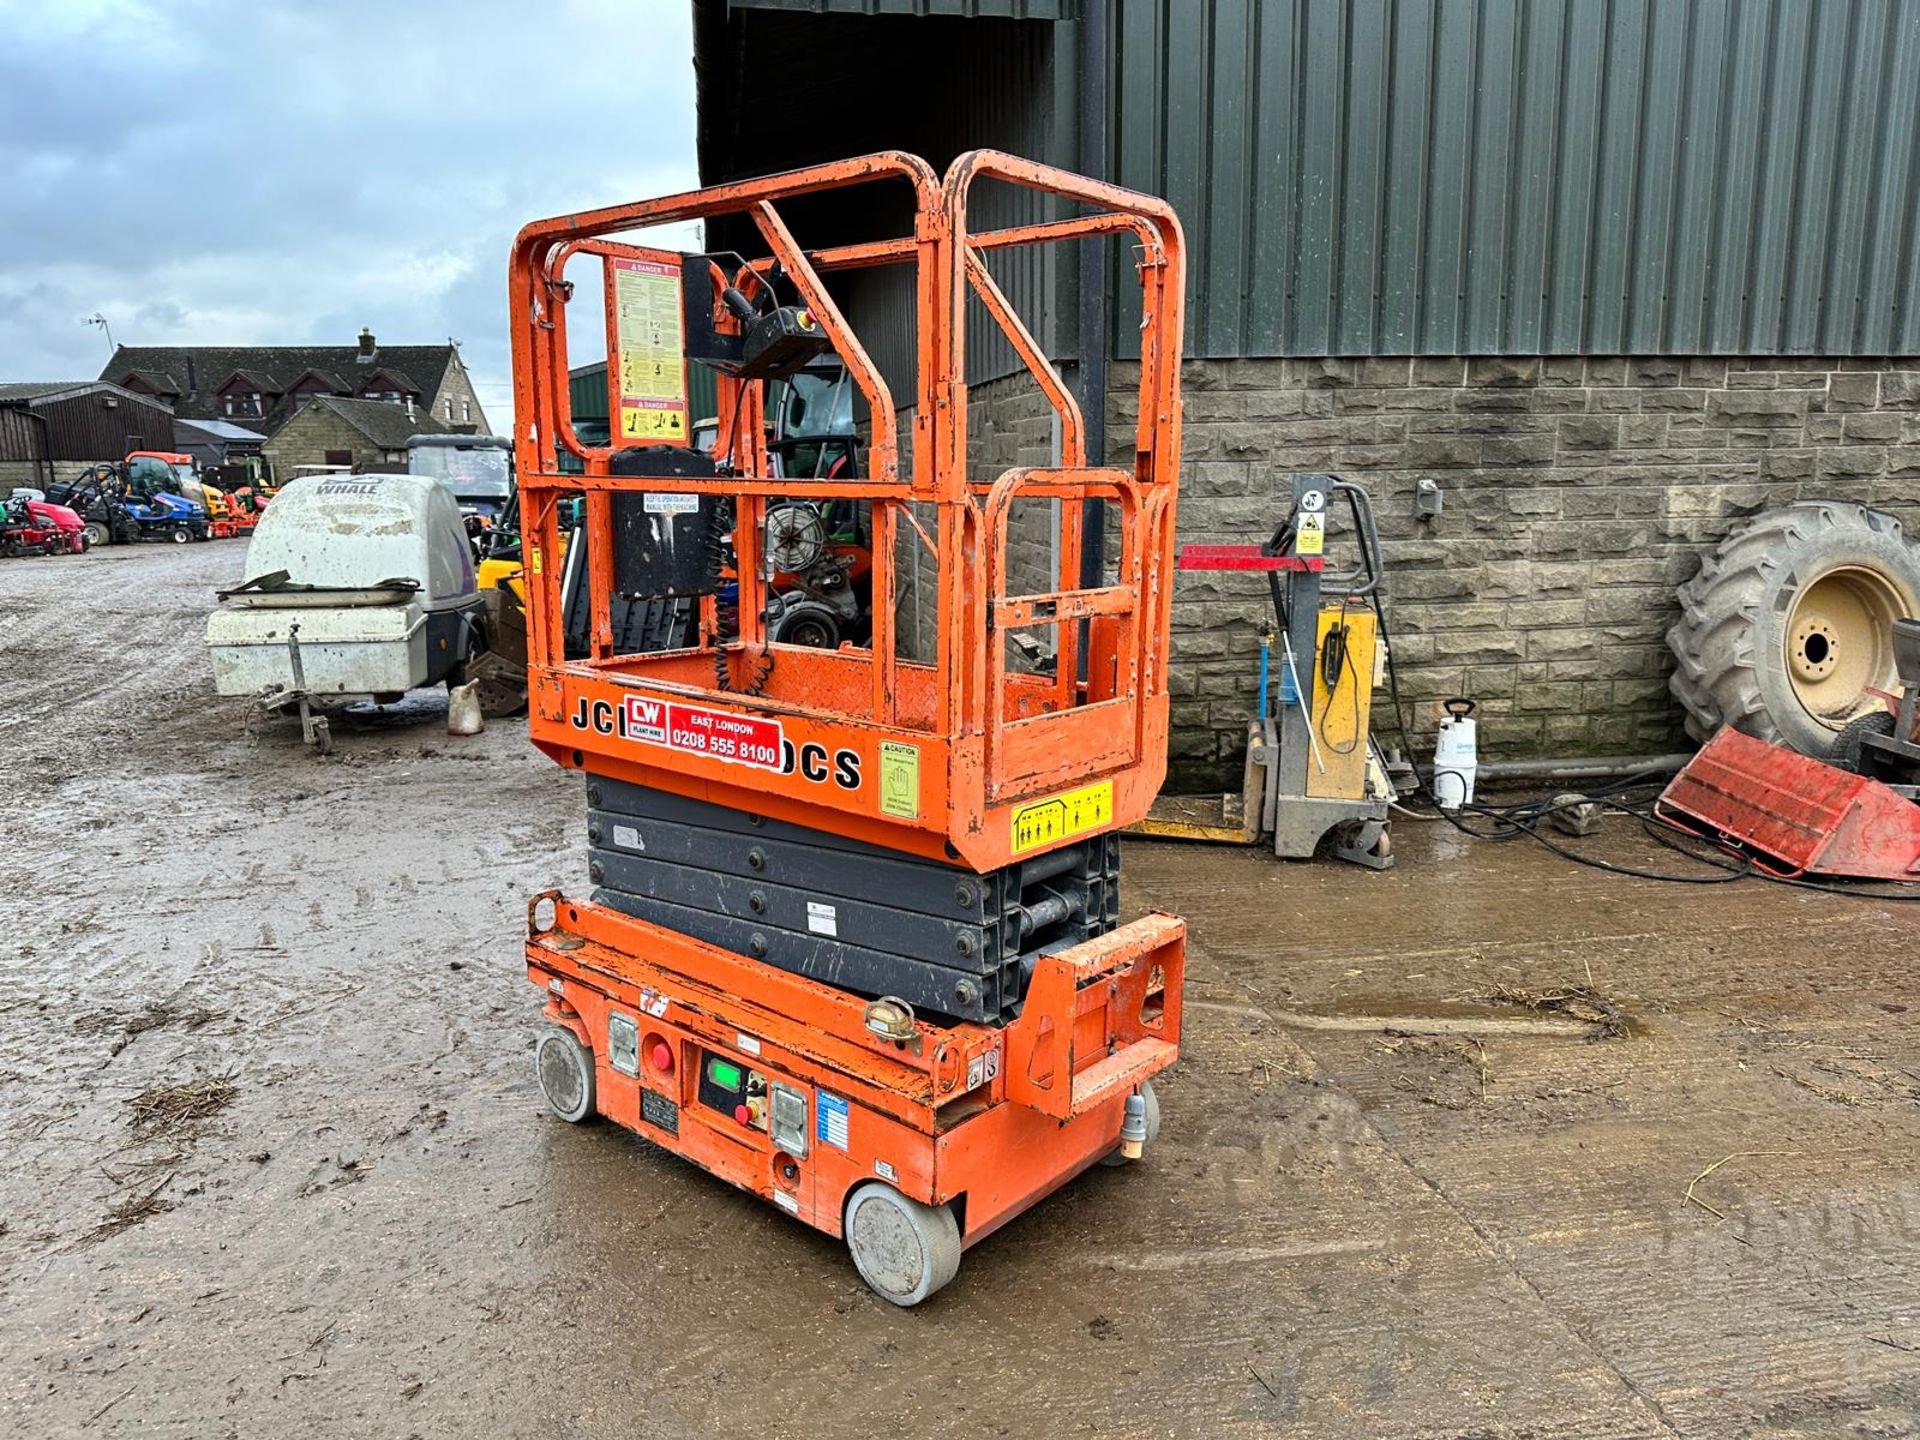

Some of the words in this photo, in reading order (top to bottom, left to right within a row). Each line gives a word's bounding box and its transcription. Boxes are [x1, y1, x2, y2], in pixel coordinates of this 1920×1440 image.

[316, 485, 377, 494] WHALE
[632, 700, 660, 724] CW
[633, 725, 649, 734] PLANT
[649, 728, 662, 738] HIRE
[691, 715, 714, 727] EAST
[716, 720, 753, 735] LONDON
[673, 729, 706, 749] 0208
[710, 736, 736, 756] 555
[740, 742, 775, 763] 8100
[890, 745, 916, 756] CAUTION
